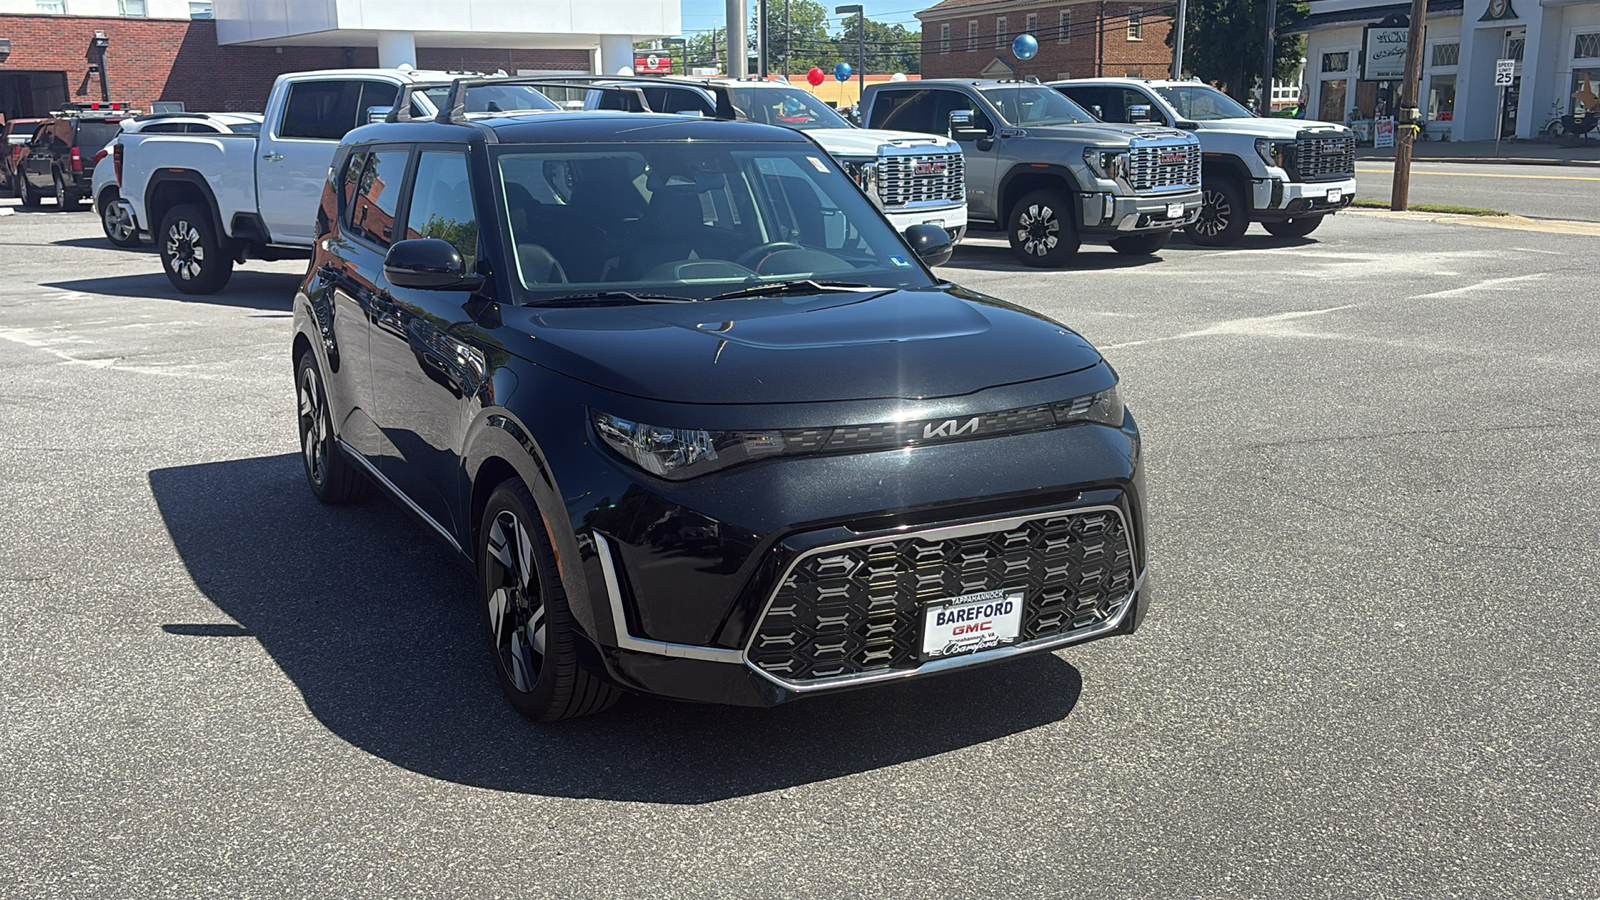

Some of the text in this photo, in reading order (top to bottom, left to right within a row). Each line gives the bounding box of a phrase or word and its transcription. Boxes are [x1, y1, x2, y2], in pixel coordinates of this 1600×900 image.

[1377, 31, 1409, 43] ACM
[1496, 73, 1512, 83] 25
[1161, 152, 1187, 162] GMC
[916, 163, 947, 173] GMC
[923, 417, 979, 438] KIA
[951, 590, 1004, 605] TAPPAHANNOCK
[936, 601, 1013, 626] BAREFORD
[952, 620, 992, 636] GMC
[943, 635, 999, 655] Bareford
